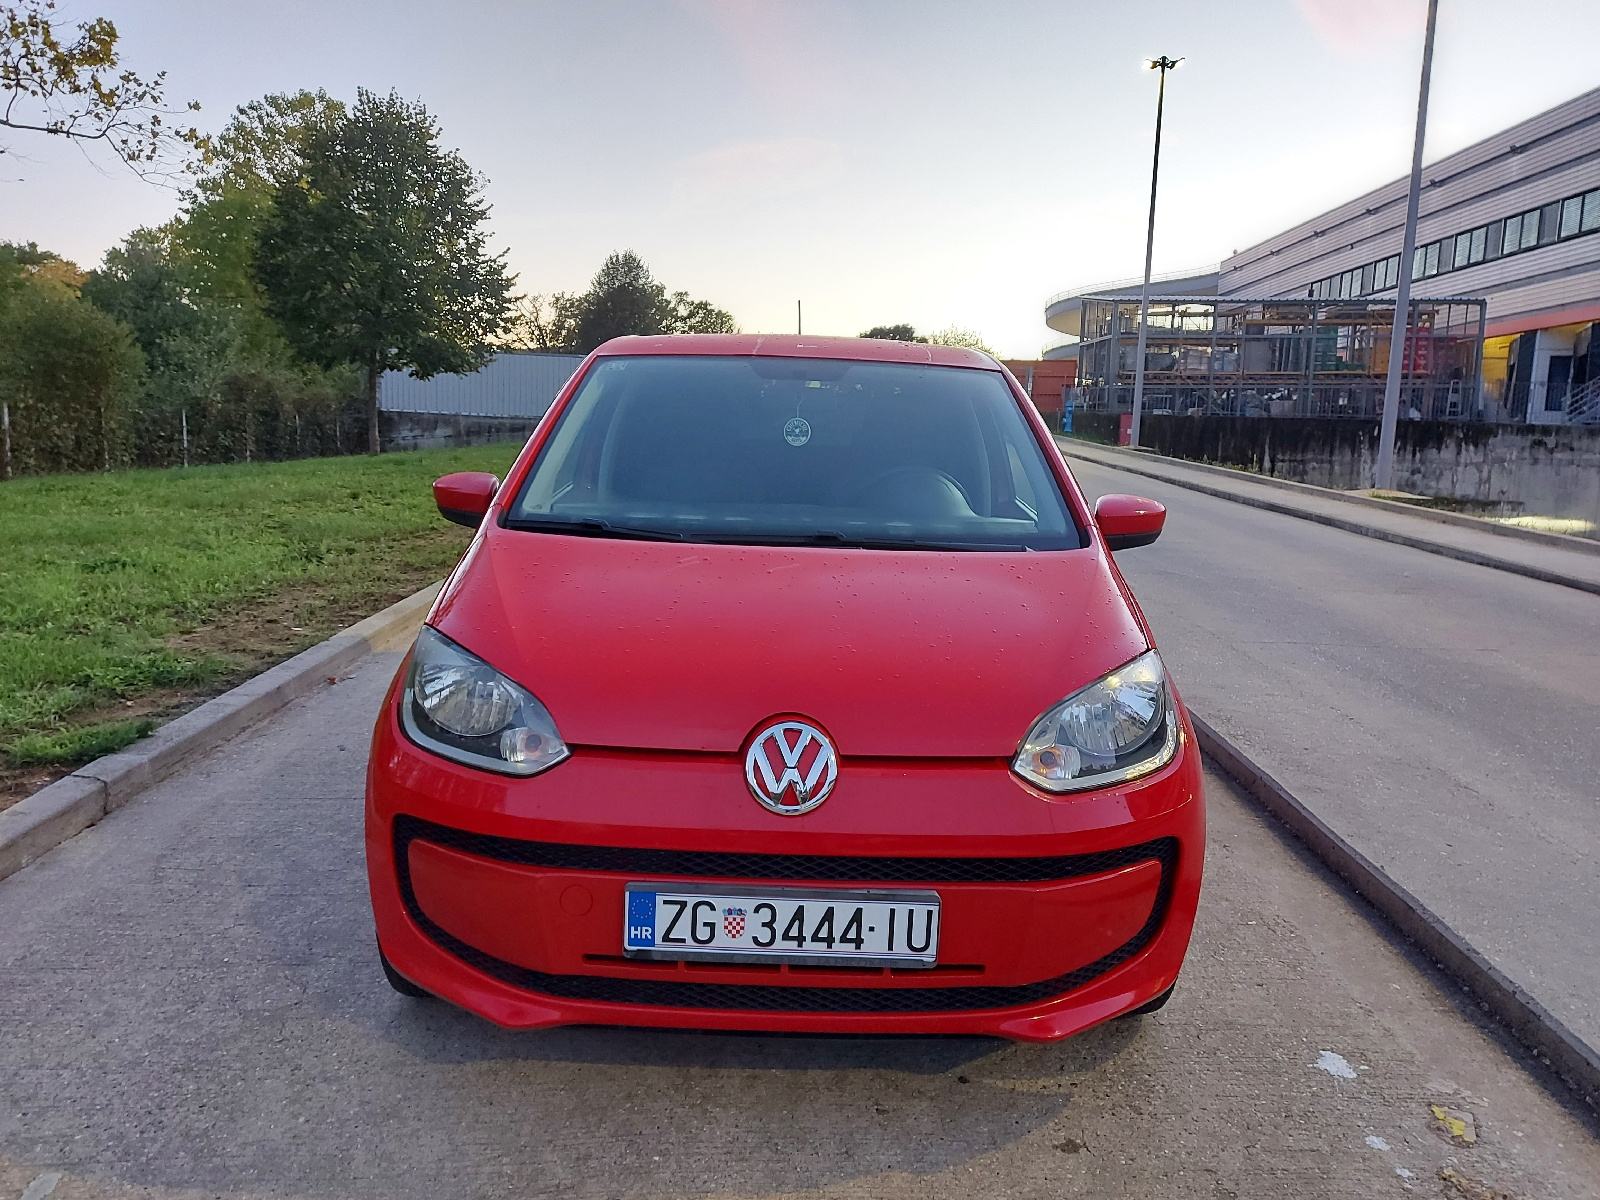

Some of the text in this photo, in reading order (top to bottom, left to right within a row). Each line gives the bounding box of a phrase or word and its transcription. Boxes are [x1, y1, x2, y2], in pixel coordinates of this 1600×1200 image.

[747, 722, 835, 812] VW
[630, 926, 652, 939] HR
[661, 900, 717, 944] ZG
